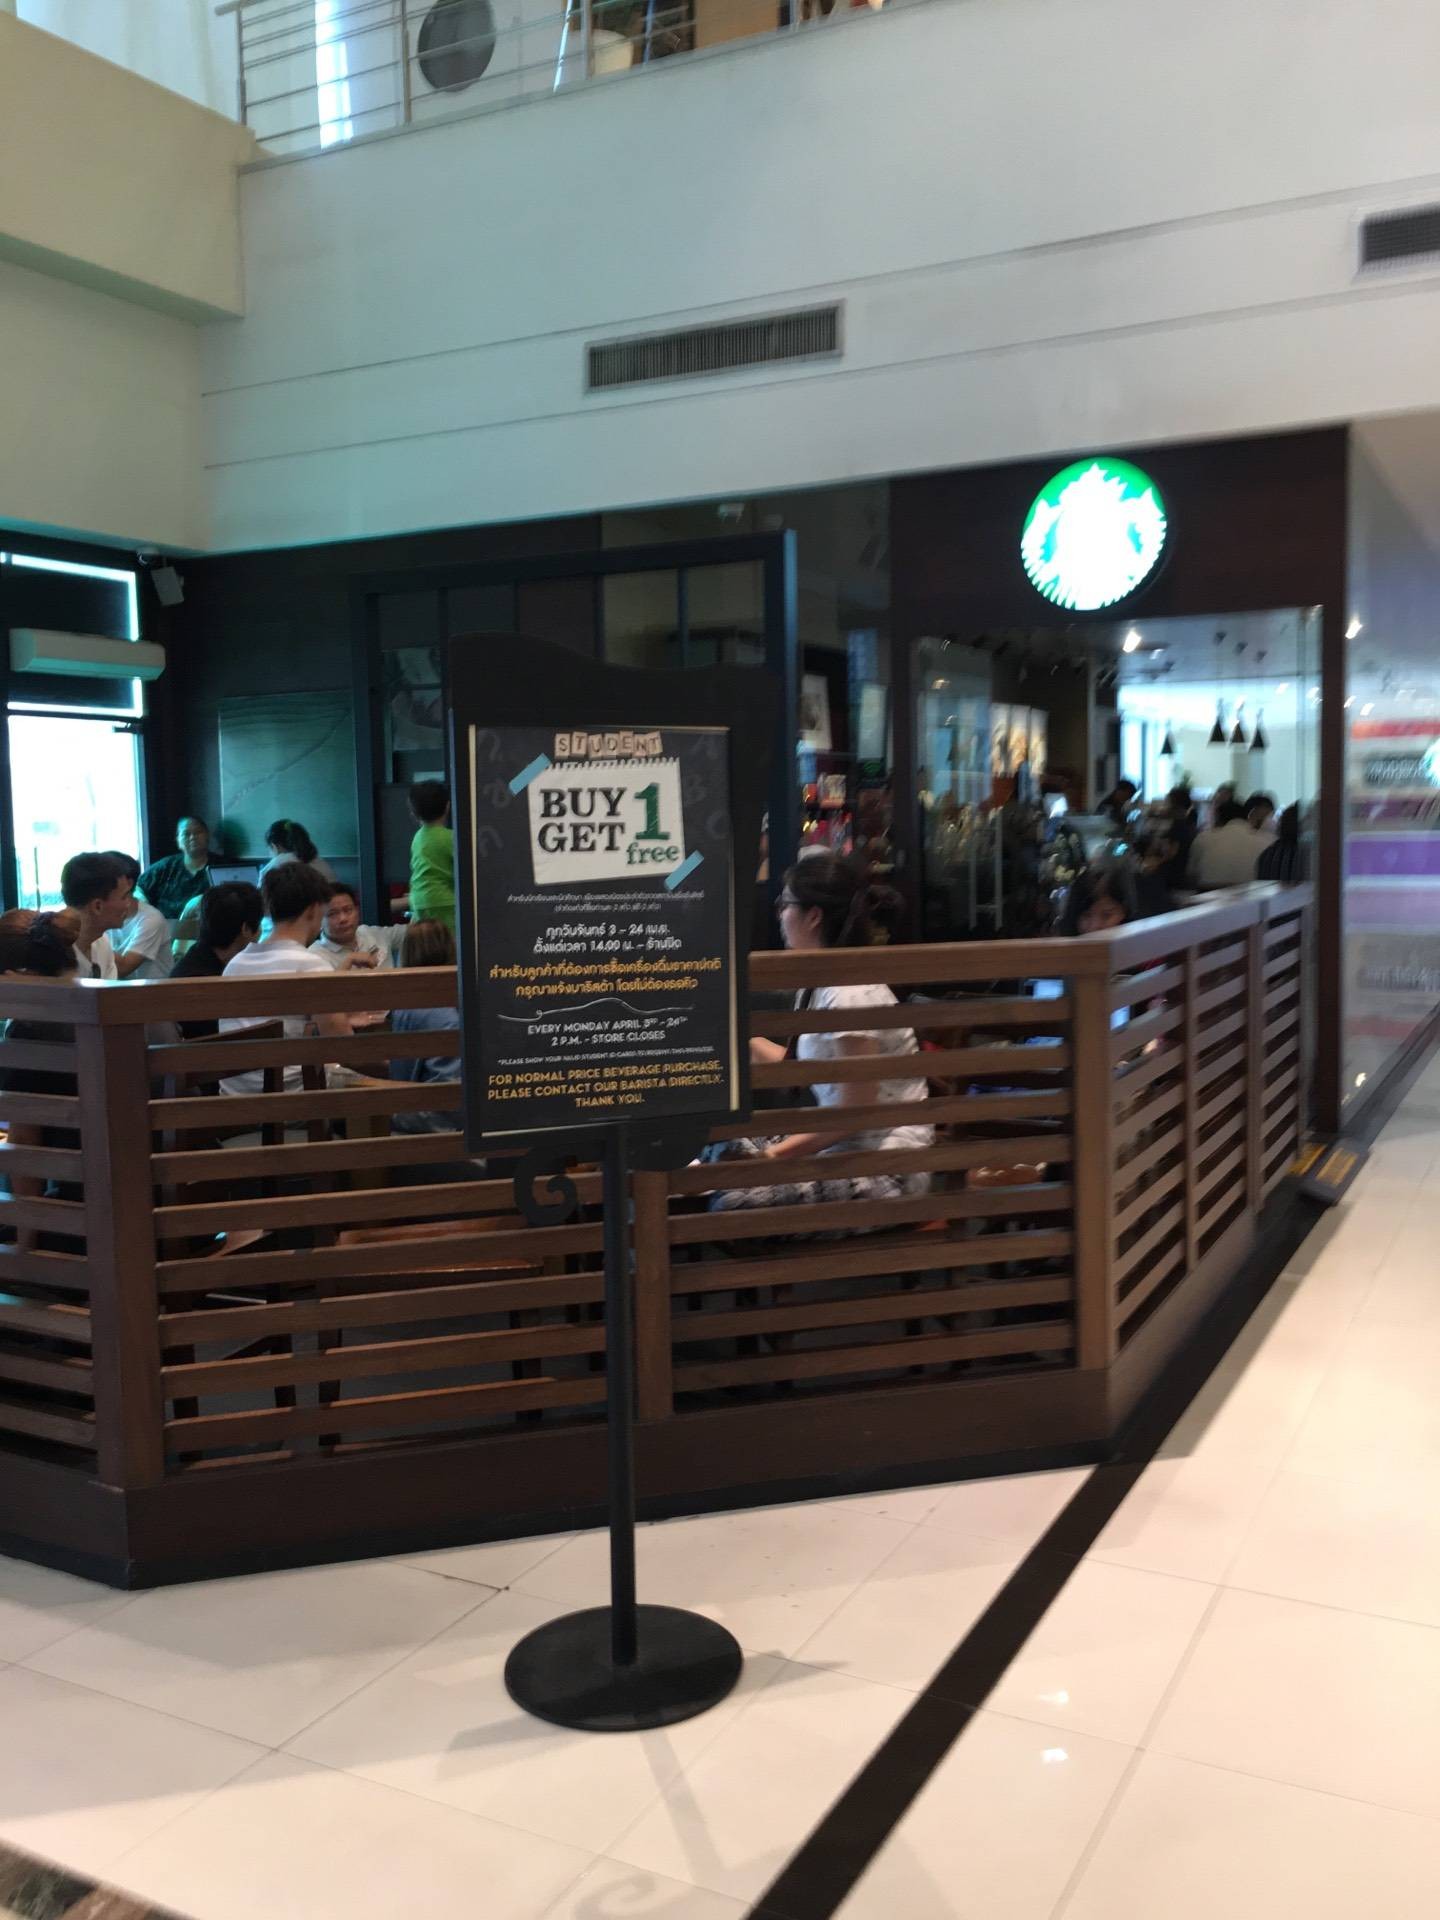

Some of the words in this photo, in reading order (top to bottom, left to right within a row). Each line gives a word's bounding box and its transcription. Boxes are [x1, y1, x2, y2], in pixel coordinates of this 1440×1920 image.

[557, 734, 660, 754] STUDENT
[539, 787, 627, 818] BUY
[633, 782, 670, 841] 1
[538, 822, 626, 853] GET
[626, 842, 679, 865] free
[546, 922, 606, 940] ทุกวันจันทร์
[609, 925, 617, 936] 3
[629, 924, 643, 936] 24
[533, 937, 587, 954] ตั้งแต่เวลา
[590, 940, 621, 952] 14.00
[646, 936, 682, 951] ร้านปิด
[527, 1023, 562, 1035] EVERY
[563, 1020, 610, 1033] MONDAY
[611, 1018, 641, 1031] APRIL
[551, 1036, 559, 1047] 2
[560, 1035, 582, 1046] P.M.
[591, 1032, 625, 1044] STORE
[626, 1030, 666, 1042] CLOSES
[488, 1074, 512, 1086] FOR
[515, 1071, 565, 1084] NORMAL
[568, 1068, 601, 1080] PRICE
[603, 1064, 661, 1078] BEVERAGE
[487, 1087, 532, 1101] PLEASE
[534, 1083, 590, 1097] CONTACT
[593, 1080, 618, 1093] OUR
[620, 1077, 667, 1090] BARISTA
[575, 1095, 614, 1109] THANK
